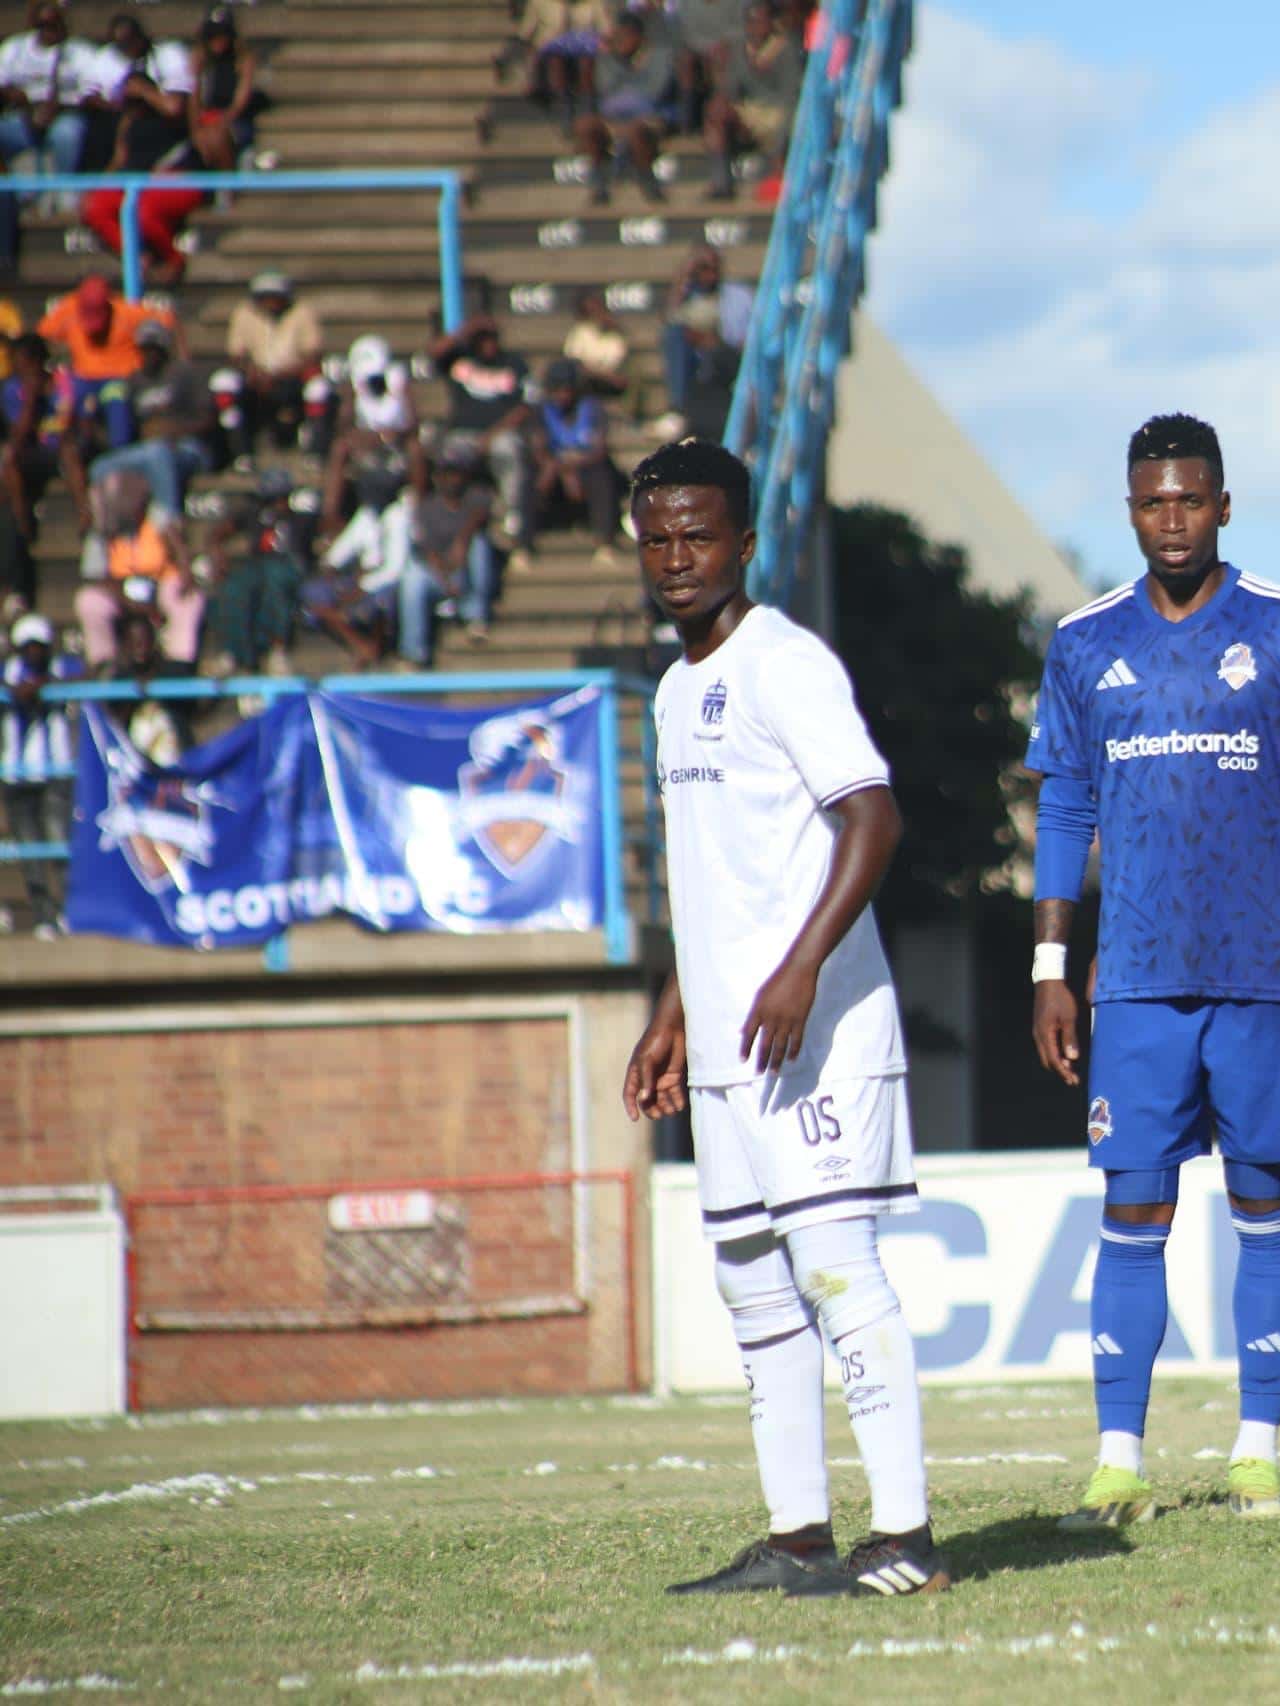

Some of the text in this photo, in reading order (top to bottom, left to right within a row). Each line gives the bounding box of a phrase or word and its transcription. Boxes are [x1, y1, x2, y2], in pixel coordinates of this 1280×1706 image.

[1105, 729, 1260, 763] Betterbrands
[1217, 756, 1259, 771] GOLD
[848, 1400, 890, 1422] mbro
